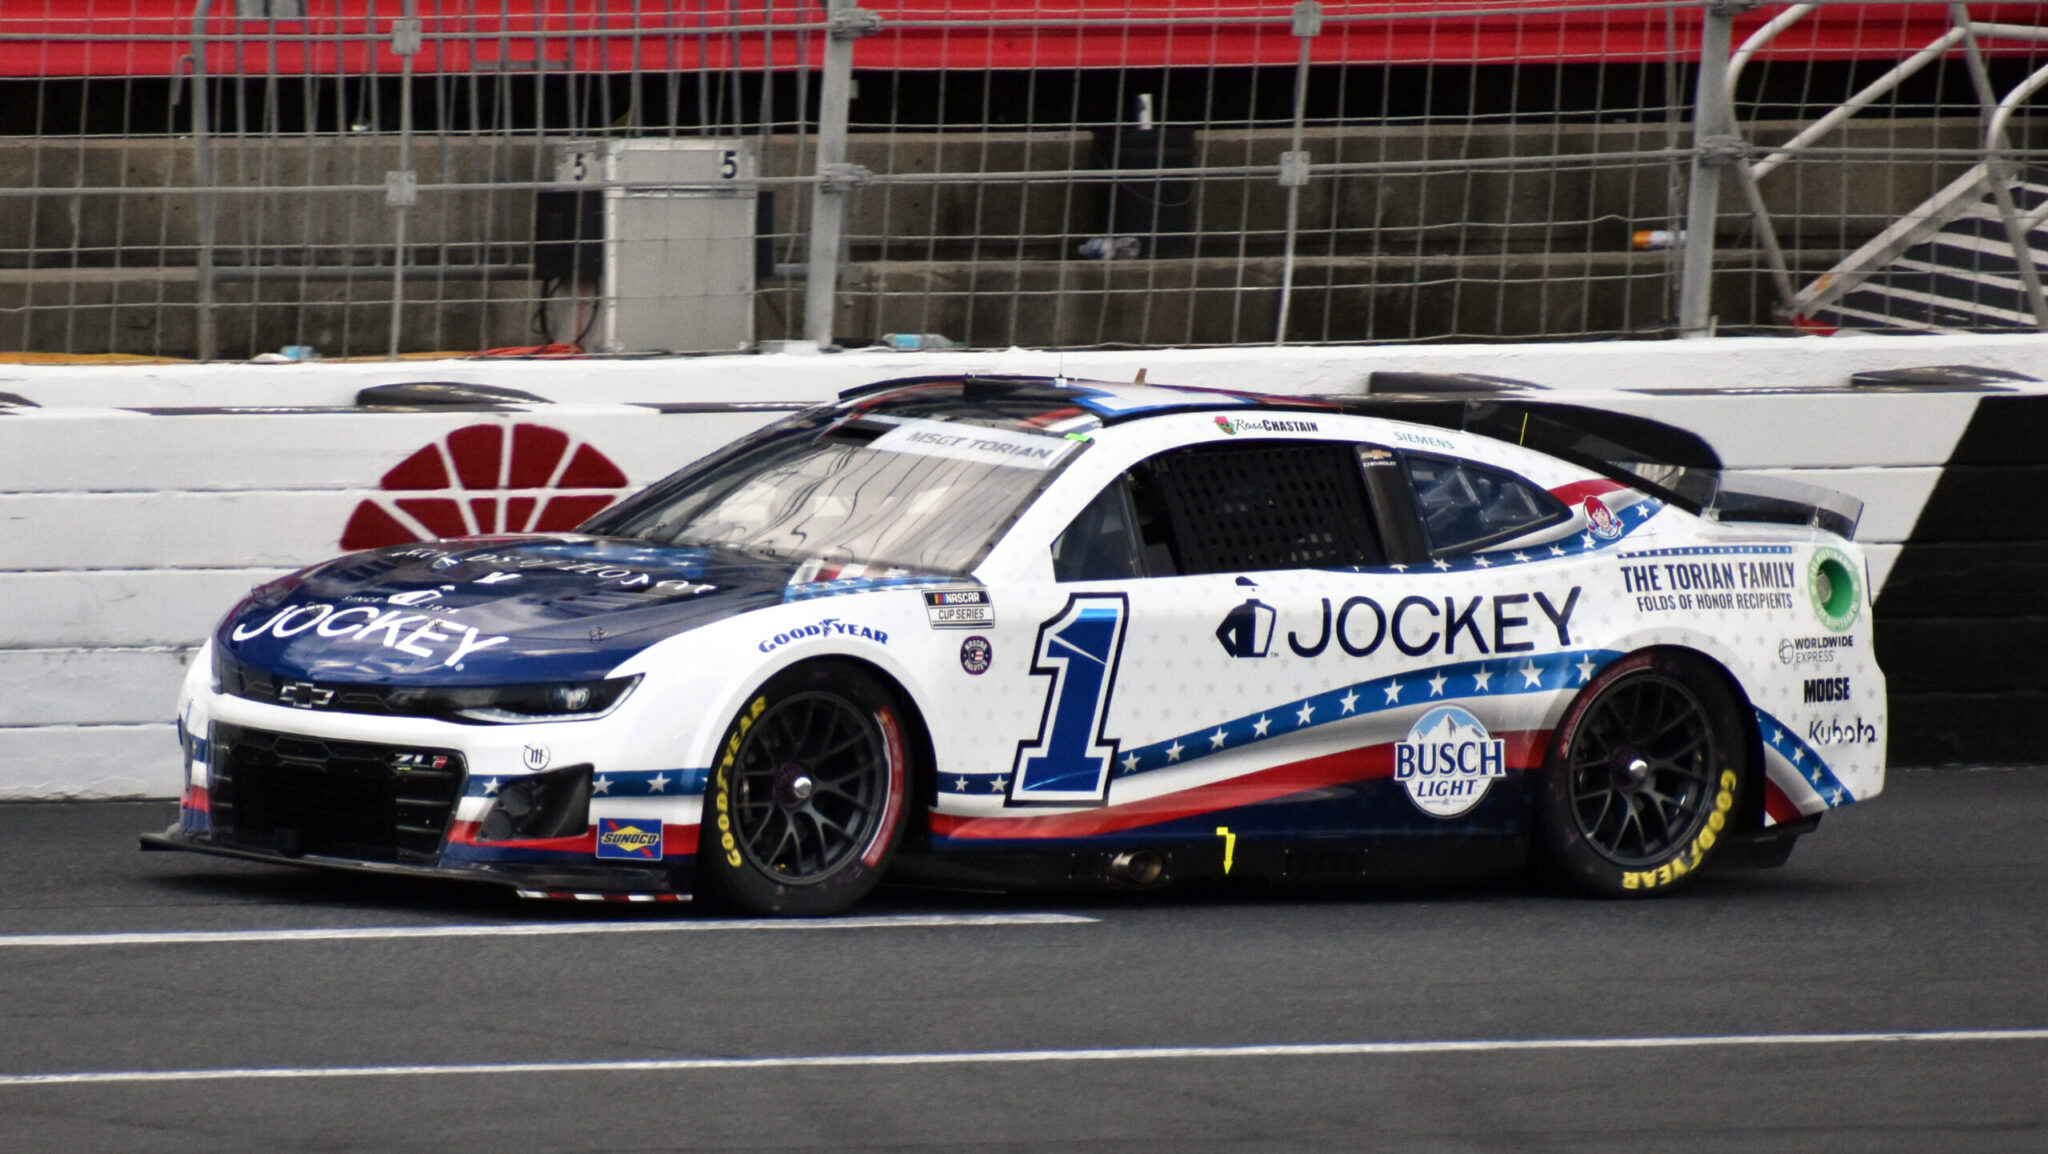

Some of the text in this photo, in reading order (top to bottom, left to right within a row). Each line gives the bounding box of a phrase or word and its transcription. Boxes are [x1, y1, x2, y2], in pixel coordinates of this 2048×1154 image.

[574, 153, 587, 181] 5
[722, 151, 738, 179] 5
[1262, 419, 1319, 432] CHASTAIN
[906, 431, 1054, 459] MSGT TORIAN
[1394, 431, 1455, 450] SIEMENS
[1621, 561, 1796, 593] THE TORIAN FAMILY
[945, 592, 981, 605] NASCAR
[1637, 592, 1793, 612] FOLDS OF HONOR RECIPIENTS
[939, 608, 985, 620] CUP SERIES
[1287, 585, 1582, 658] JOCKEY
[232, 604, 510, 667] JOCKEY
[758, 618, 889, 654] GOODYEAR
[1795, 635, 1854, 650] WORLDWIDE
[1796, 650, 1835, 664] EXPRESS
[1003, 592, 1130, 808] 1
[1803, 677, 1850, 703] MOOSE
[1809, 717, 1876, 746] Kubota
[1396, 740, 1503, 780] BUSCH
[1416, 780, 1479, 798] LIGHT
[600, 830, 659, 847] SUNOCO
